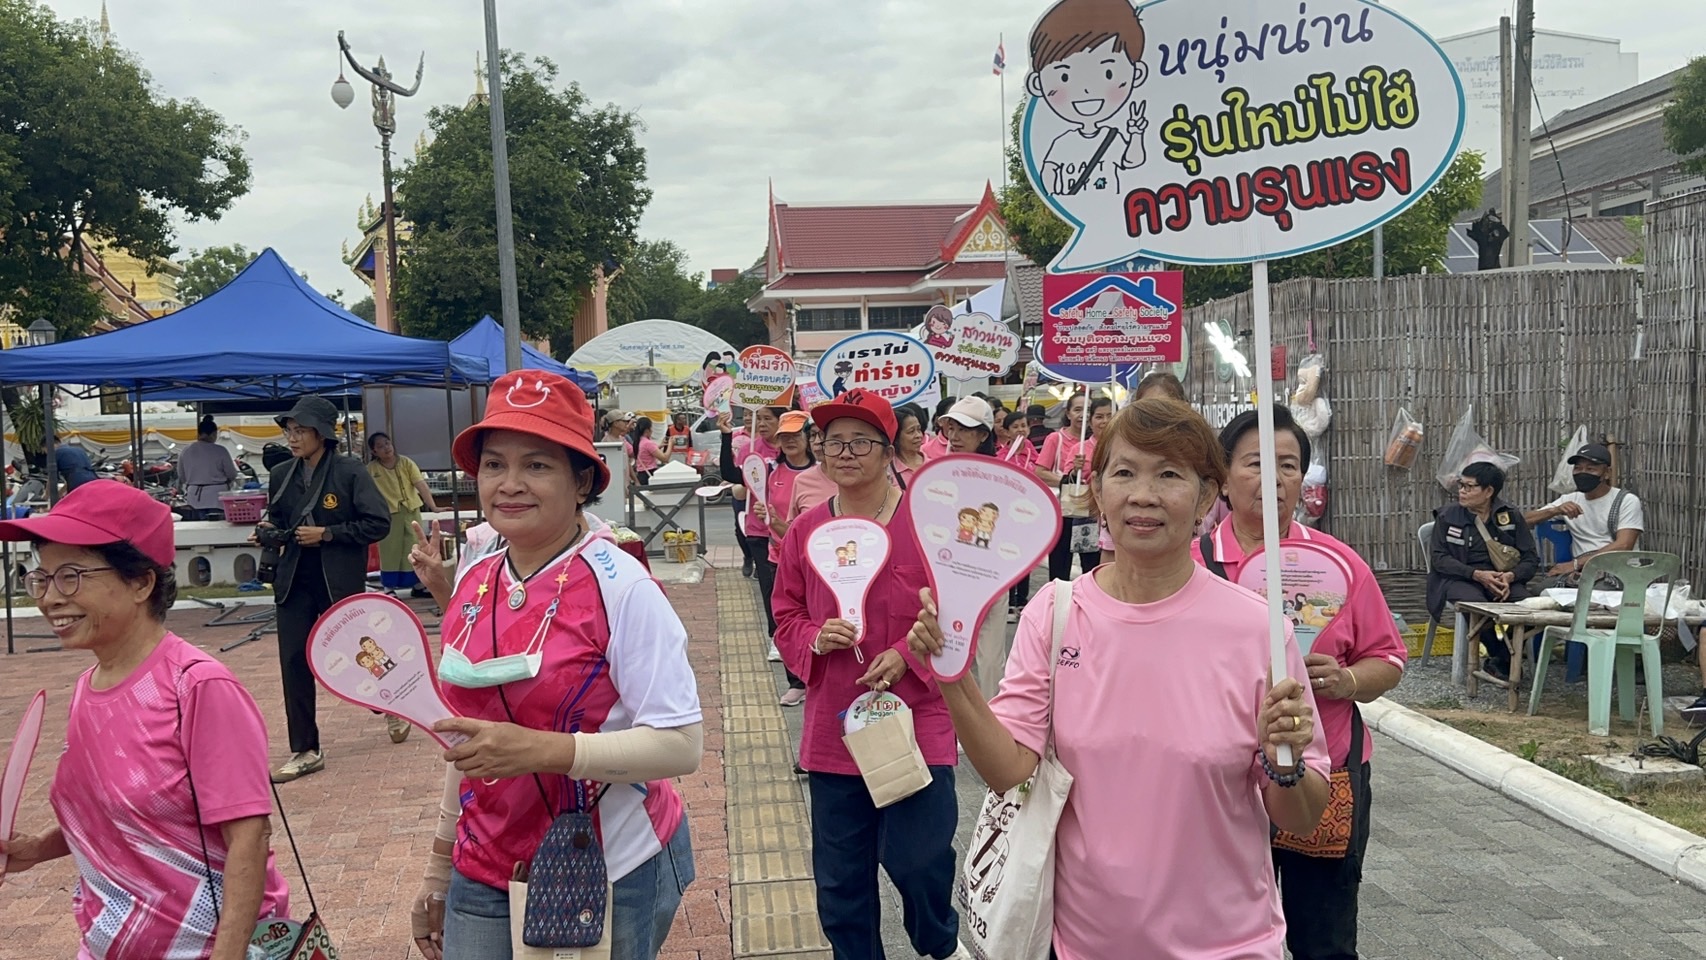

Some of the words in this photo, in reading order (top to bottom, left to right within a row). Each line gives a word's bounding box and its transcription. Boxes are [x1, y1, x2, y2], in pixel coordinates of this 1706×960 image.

[1159, 2, 1374, 83] หนุ่มน่าน
[1160, 65, 1420, 175] รุ่นใหม่ไม่ใช้
[1124, 147, 1412, 240] ความรุนแรง
[1060, 308, 1083, 321] Safety
[1086, 308, 1107, 318] Home
[1113, 308, 1138, 321] Safety
[1140, 307, 1168, 320] Society
[962, 325, 1013, 347] สาวน่าน
[1053, 332, 1171, 345] ร่วมยุติความรุนแรง
[742, 349, 790, 371] เพิ่มรัก
[935, 351, 1001, 373] ความรุนแรง
[741, 370, 792, 384] ให้ครอบครัว
[854, 360, 920, 383] ทำร้าย
